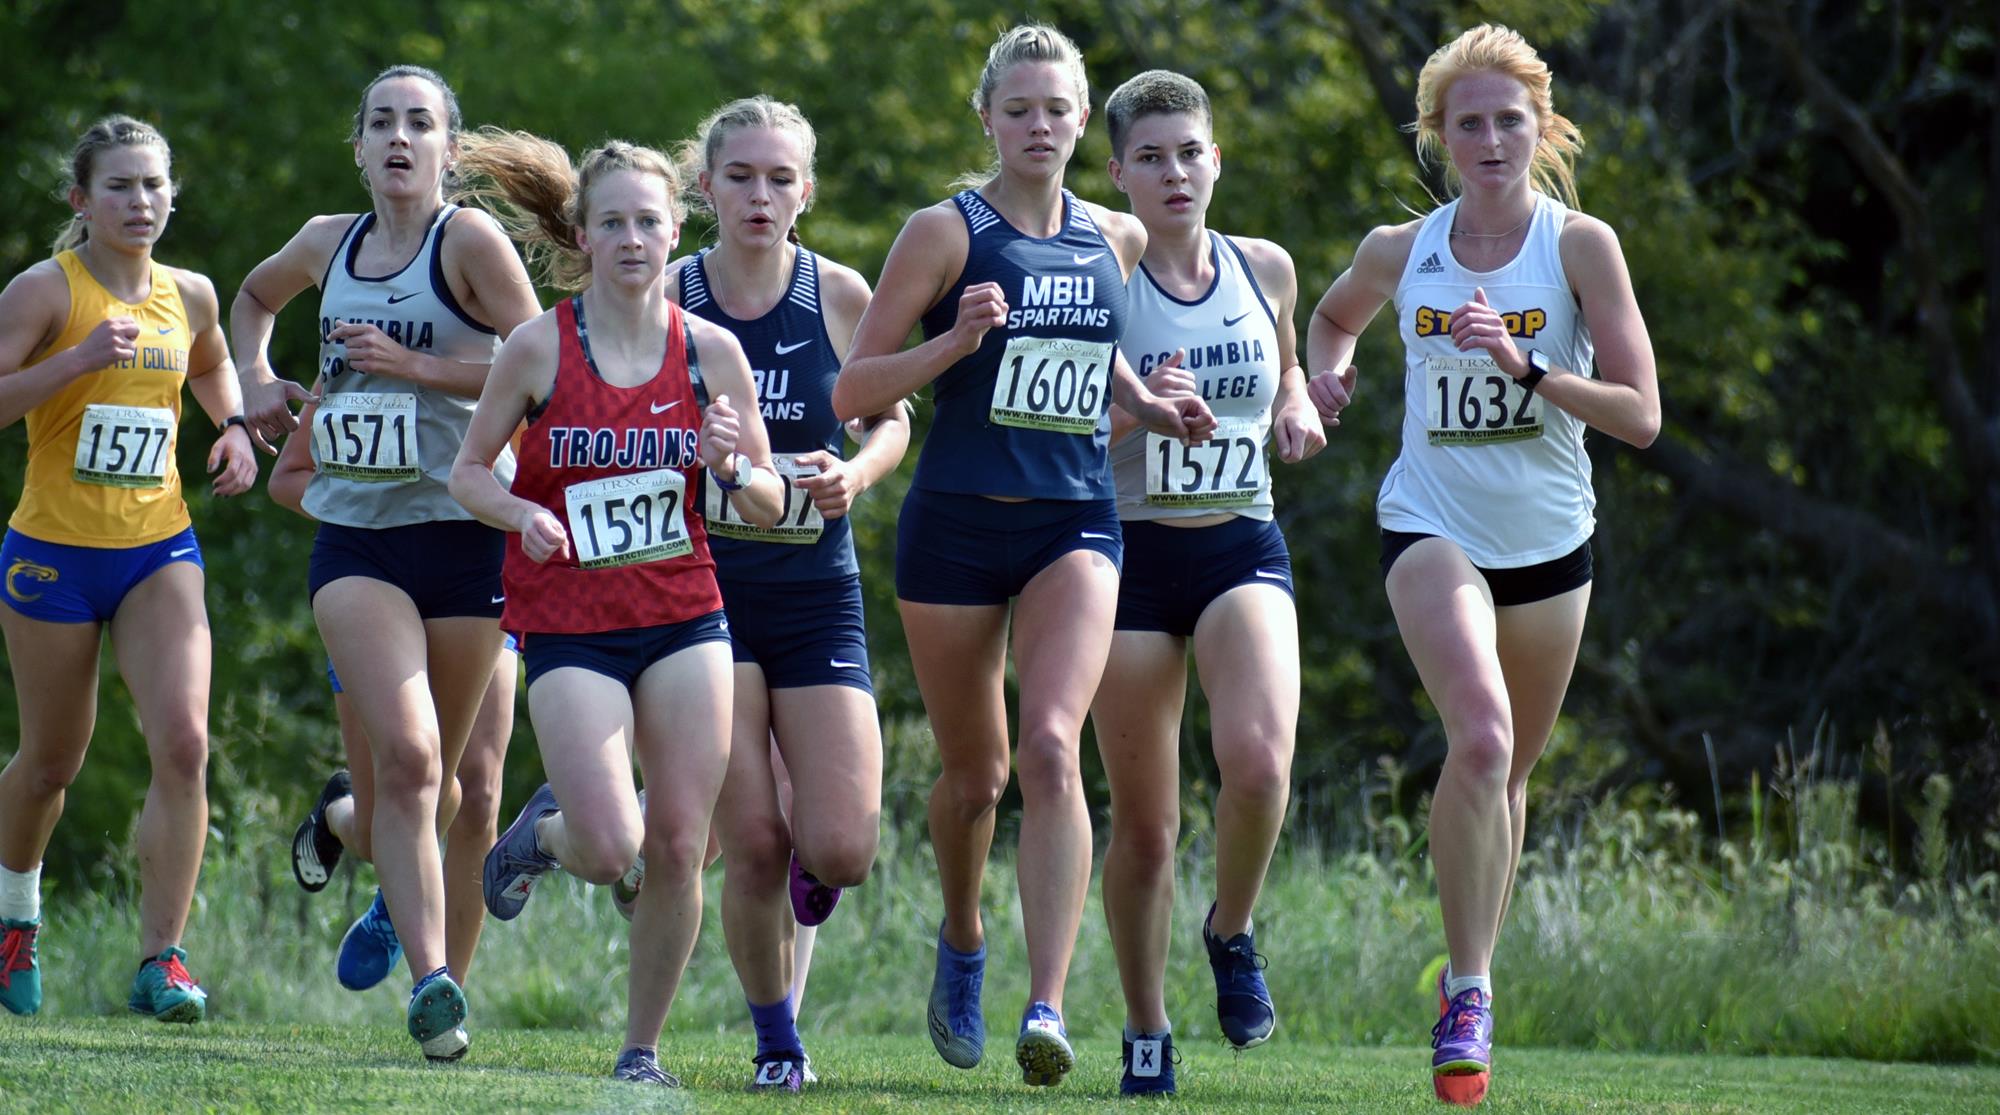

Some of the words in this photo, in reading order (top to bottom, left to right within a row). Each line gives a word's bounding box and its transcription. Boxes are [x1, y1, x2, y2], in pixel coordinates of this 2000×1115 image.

[1417, 265, 1444, 273] adidas
[1022, 276, 1094, 307] MBU
[1007, 308, 1110, 329] SPARTANS
[1416, 305, 1546, 338] STOP
[1040, 341, 1082, 352] TRXC
[343, 395, 382, 405] TRXC
[1006, 355, 1099, 417] 1606
[994, 408, 1095, 426] WWW.TRXCTIMING.COM
[1438, 376, 1536, 429] 1632
[323, 413, 406, 466] 1571
[1431, 425, 1539, 438] WWW.TRXCTIMING.COM
[87, 423, 168, 474] 1577
[550, 427, 697, 469] TROJANS
[325, 463, 416, 475] WWW.TRXCTIMING.COM
[1158, 437, 1258, 493] 1572
[599, 475, 648, 490] TRXC
[580, 490, 681, 557] 1592
[584, 540, 687, 567] WWW.TRXCTIMING.COM
